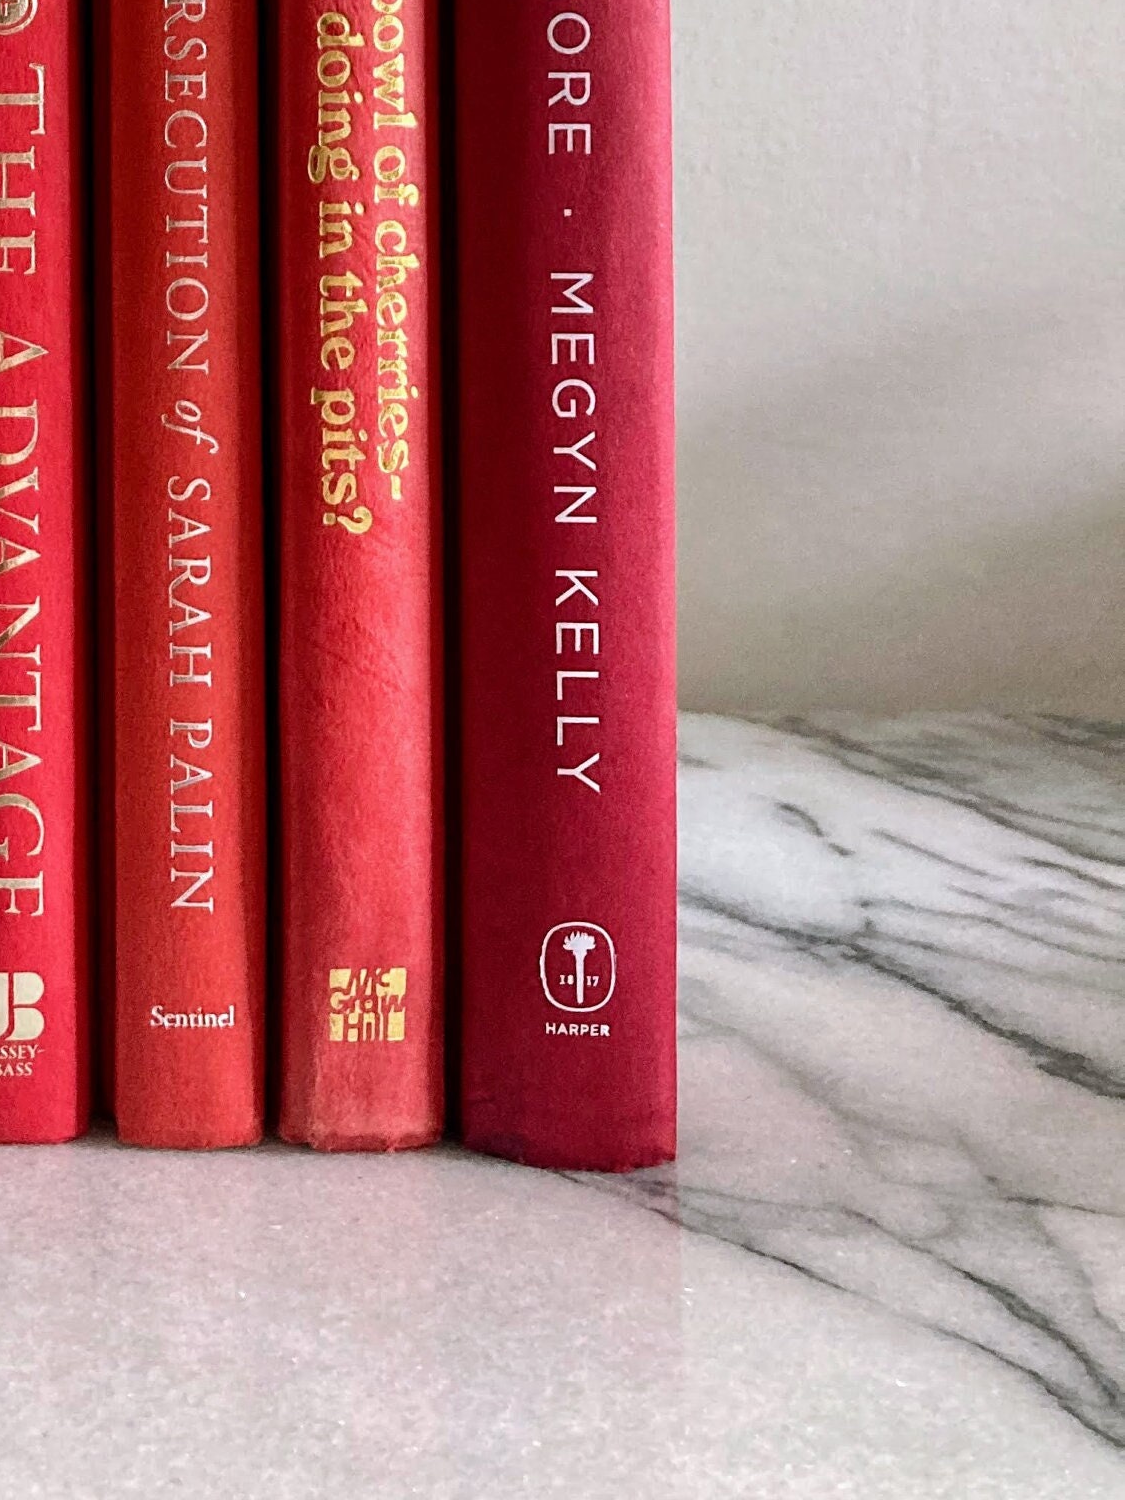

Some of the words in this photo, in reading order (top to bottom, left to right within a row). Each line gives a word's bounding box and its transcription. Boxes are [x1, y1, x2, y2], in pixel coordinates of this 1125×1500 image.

[307, 11, 366, 183] doing
[314, 196, 368, 256] in
[373, 145, 419, 208] of
[319, 273, 369, 372] the
[161, 399, 220, 455] of
[550, 272, 598, 524] MEGYN
[311, 387, 373, 531] pits?
[167, 476, 212, 688] SARAH
[555, 569, 601, 793] KELLY
[169, 718, 214, 915] PALIN
[150, 1004, 235, 1030] Sentinel
[545, 1021, 611, 1037] HARPER
